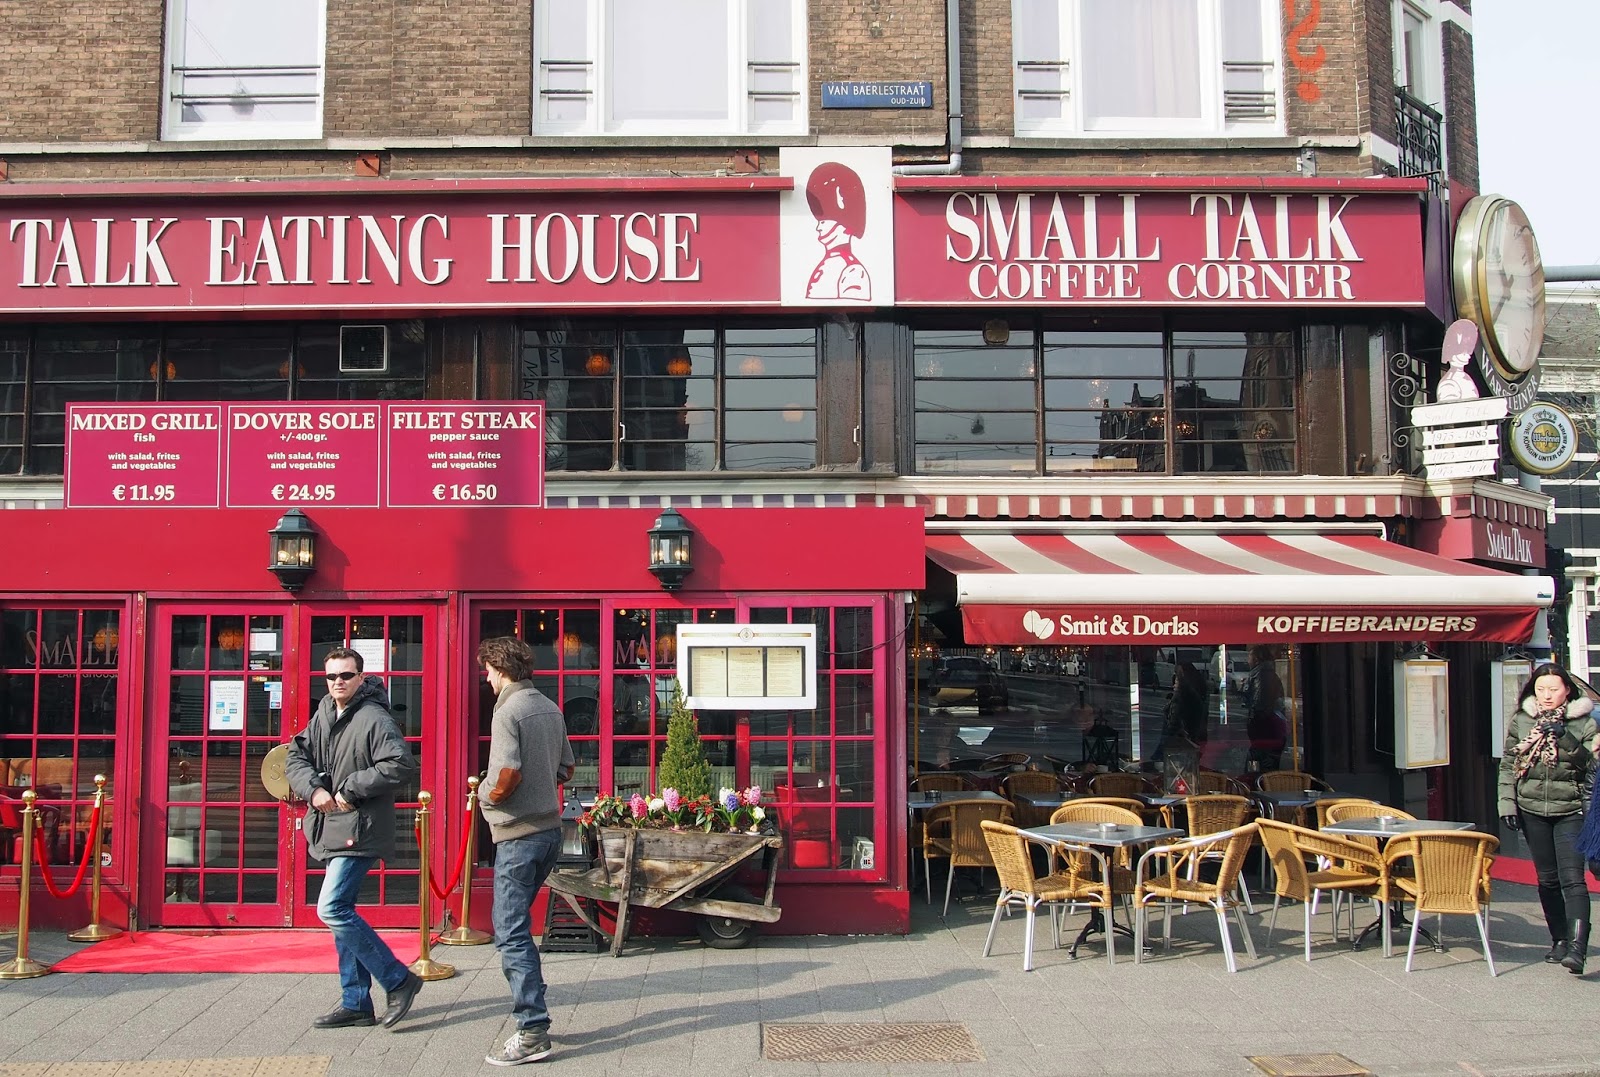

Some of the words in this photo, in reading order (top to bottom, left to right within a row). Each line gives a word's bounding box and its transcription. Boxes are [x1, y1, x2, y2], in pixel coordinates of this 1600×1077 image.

[827, 85, 849, 96] VAN
[853, 85, 926, 96] BAERLESTRAAT
[890, 97, 926, 106] OUD-ZUID
[944, 192, 1161, 263] SMALL
[1189, 193, 1364, 262] TALK
[8, 216, 179, 287] TALK
[203, 213, 453, 286] EATING
[486, 210, 701, 284] HOUSE
[967, 263, 1142, 300] COFFEE
[1166, 262, 1356, 301] CORNER
[72, 412, 146, 430] MIXED
[151, 412, 218, 431] GRILL
[232, 412, 314, 430] DOVER
[318, 412, 376, 430] SOLE
[392, 411, 456, 430] FILET
[460, 411, 537, 430] STEAK
[133, 432, 156, 443] fish
[429, 432, 467, 443] pepper
[469, 432, 500, 441] sauce
[1432, 432, 1454, 442] 1975
[1464, 429, 1488, 439] 1985
[107, 452, 127, 461] with
[128, 452, 155, 462] salad,
[156, 452, 181, 461] frites
[266, 451, 286, 460] with
[287, 451, 314, 461] salad,
[315, 451, 340, 460] frites
[427, 451, 447, 460] with
[448, 451, 475, 461] salad,
[476, 451, 501, 460] frites
[111, 461, 128, 470] and
[129, 461, 177, 471] vegetables
[270, 461, 287, 470] and
[288, 461, 336, 471] vegetables
[431, 460, 448, 469] and
[449, 460, 497, 471] vegetables
[111, 484, 126, 501] €
[129, 484, 175, 501] 11.95
[271, 484, 285, 501] €
[288, 484, 336, 501] 24.95
[432, 483, 446, 501] €
[449, 483, 497, 501] 16.50
[1486, 522, 1514, 561] SMALL
[1511, 527, 1533, 564] TALK
[1060, 614, 1108, 636] Smit
[1109, 614, 1130, 636] &
[1132, 614, 1199, 637] Dorlas
[1257, 615, 1478, 634] KOFFIEBRANDERS
